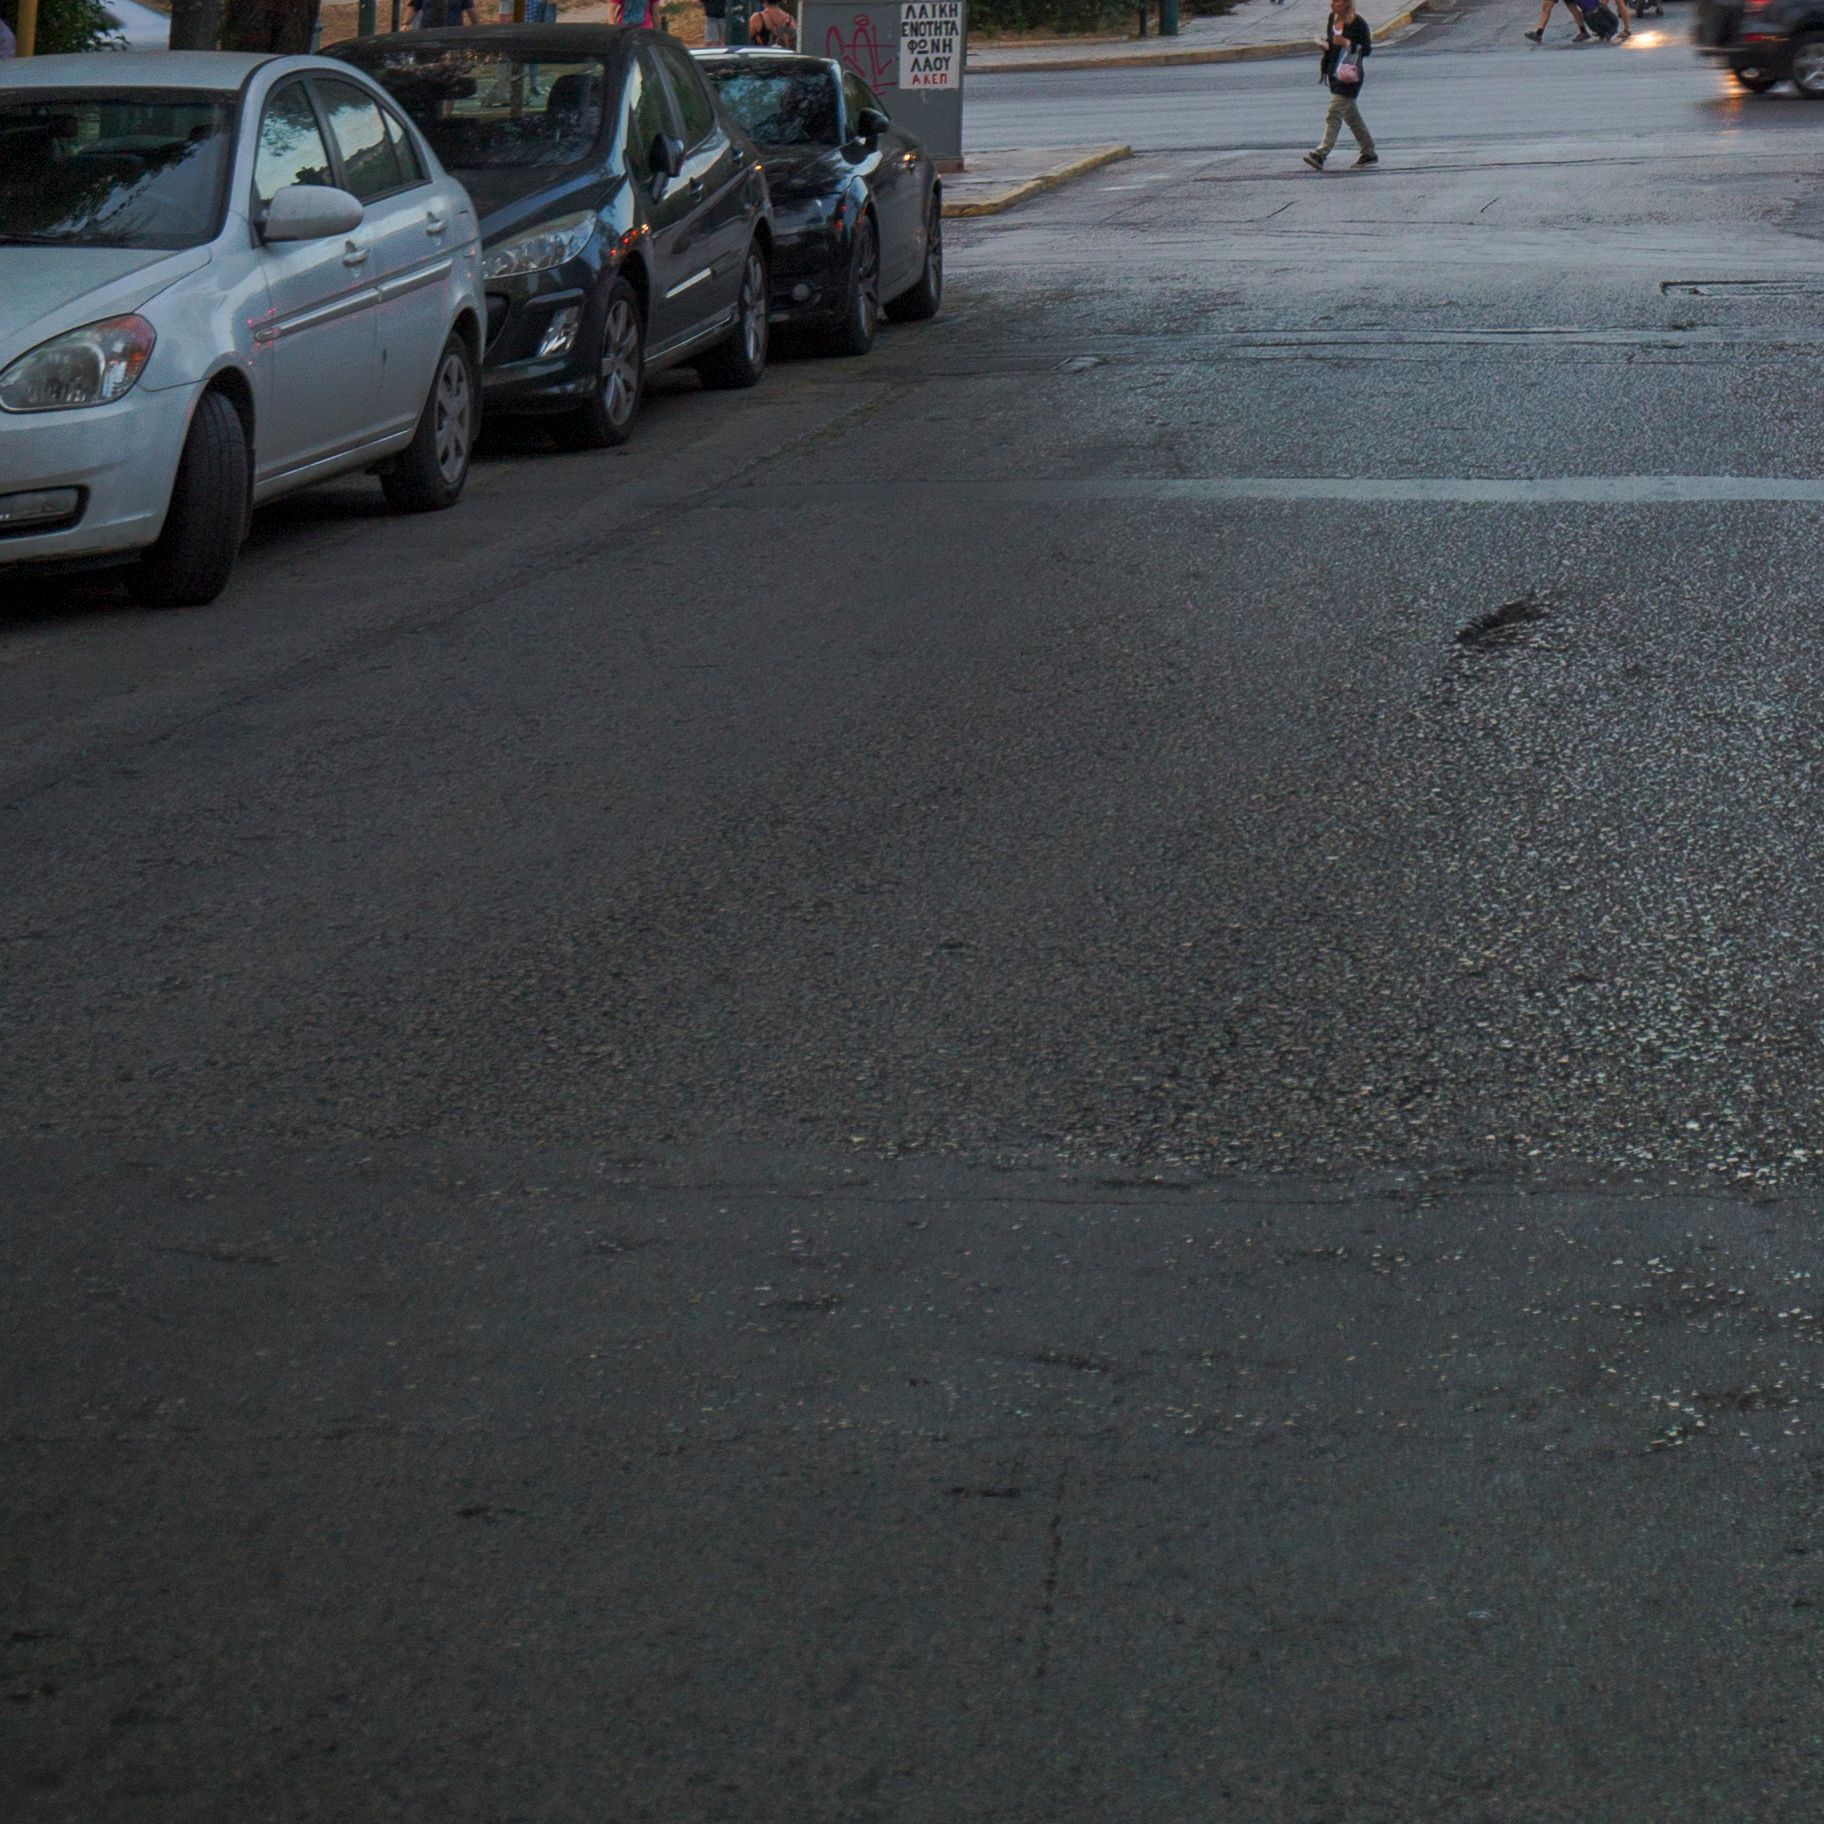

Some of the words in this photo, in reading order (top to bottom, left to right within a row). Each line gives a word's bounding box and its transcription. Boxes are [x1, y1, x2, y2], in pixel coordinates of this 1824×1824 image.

[901, 20, 960, 37] ΕΝΟΤΗΤΑ
[907, 38, 953, 54] ΦΩΝΗ
[910, 55, 951, 72] ΛΑΟΥ
